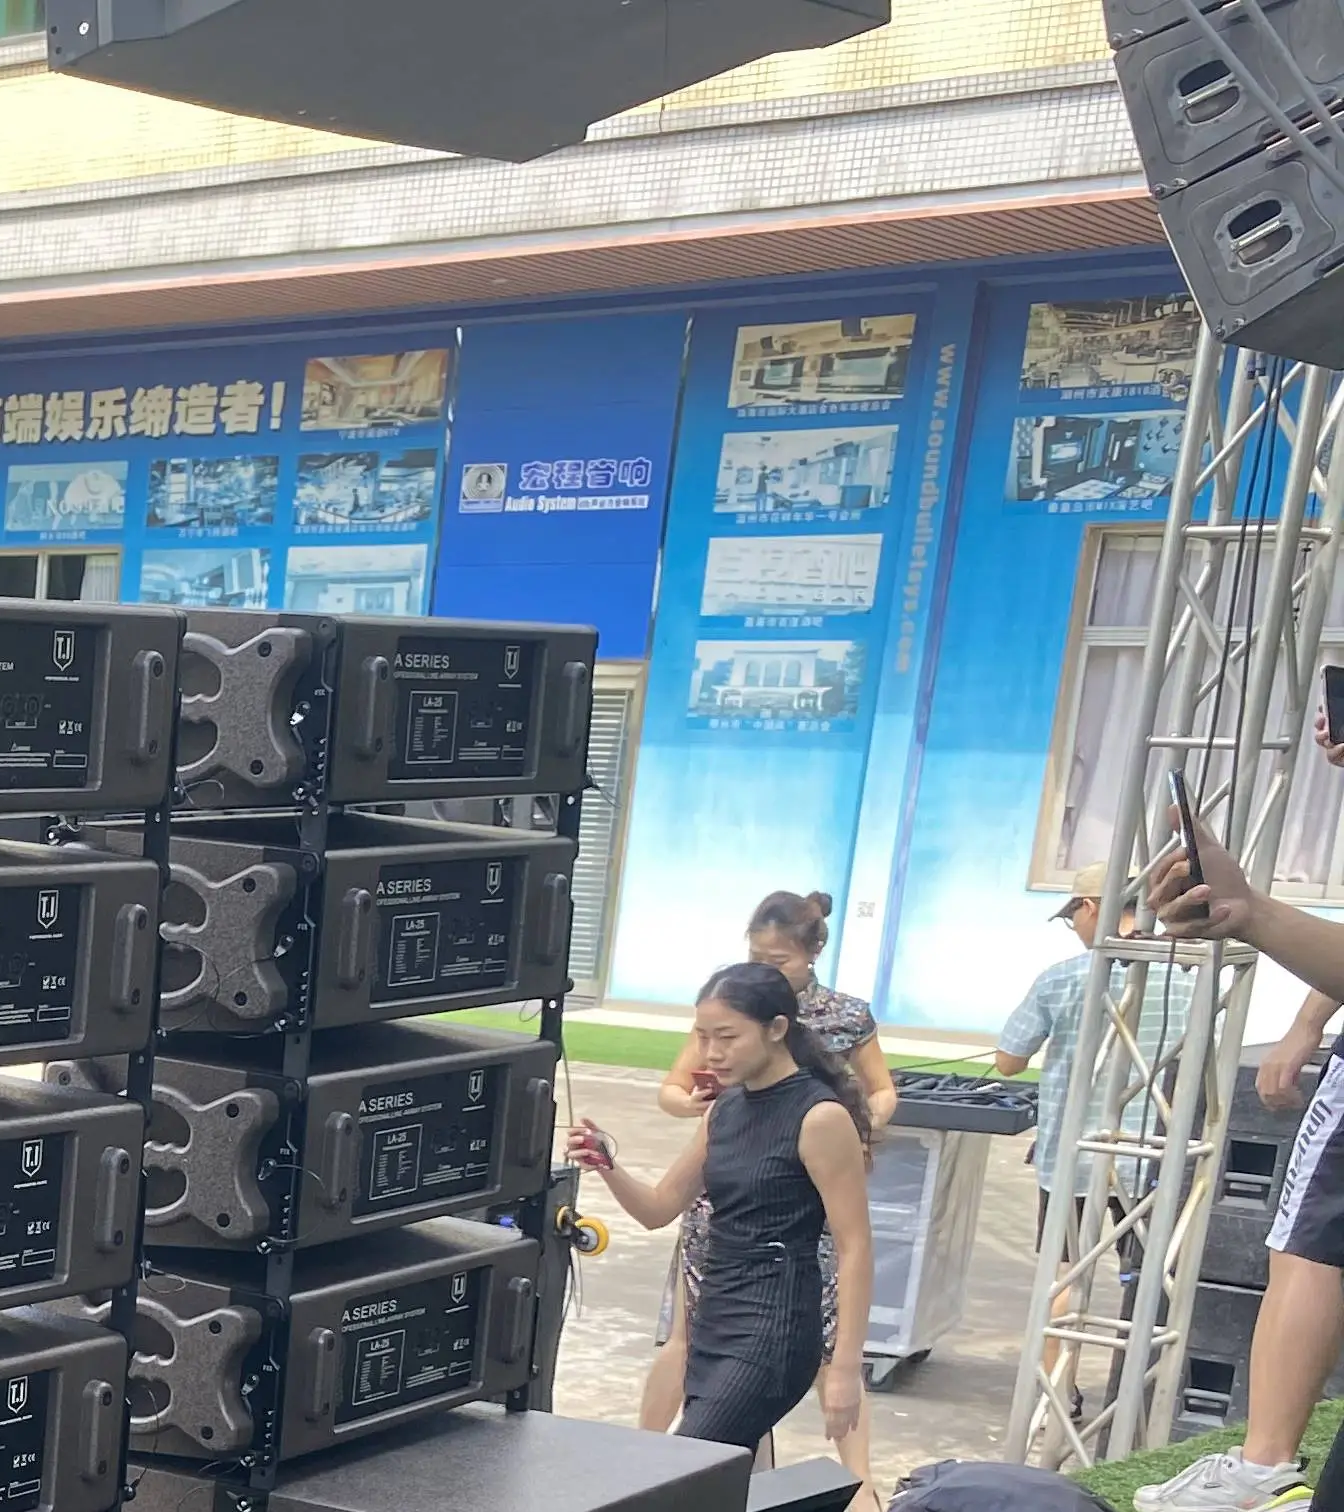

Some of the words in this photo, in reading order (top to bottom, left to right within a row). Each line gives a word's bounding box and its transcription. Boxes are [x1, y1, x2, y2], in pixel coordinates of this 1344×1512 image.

[518, 456, 653, 491] 宏程音响
[404, 653, 450, 669] SERIES
[386, 877, 432, 895] SERIES
[368, 1092, 414, 1113] SERIES
[351, 1298, 397, 1322] SERIES
